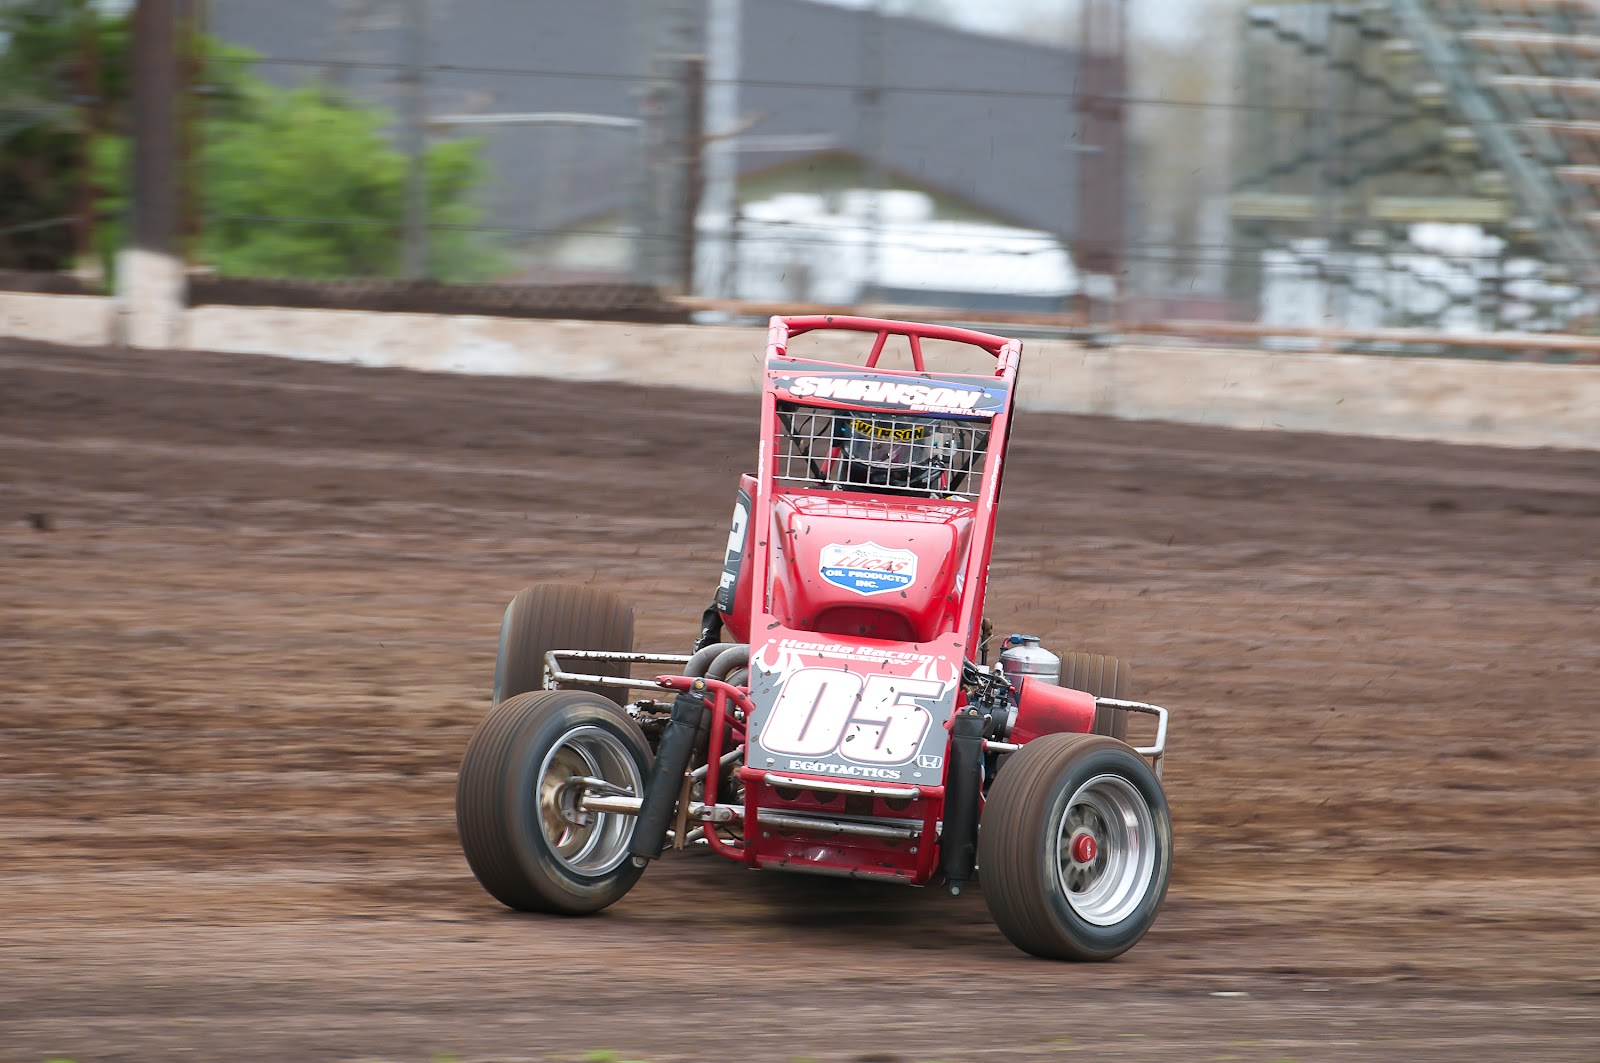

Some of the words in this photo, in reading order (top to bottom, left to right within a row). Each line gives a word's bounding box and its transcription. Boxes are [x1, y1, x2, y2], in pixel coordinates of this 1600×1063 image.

[790, 377, 981, 409] SWANSON
[832, 556, 909, 572] LUCAS
[825, 569, 845, 577] OIL
[848, 571, 909, 584] PRODUCTS
[855, 580, 879, 589] INC.
[778, 638, 855, 653] Honda
[856, 646, 935, 663] Racing
[759, 666, 947, 766] 05
[788, 759, 902, 780] EGOTACTICS
